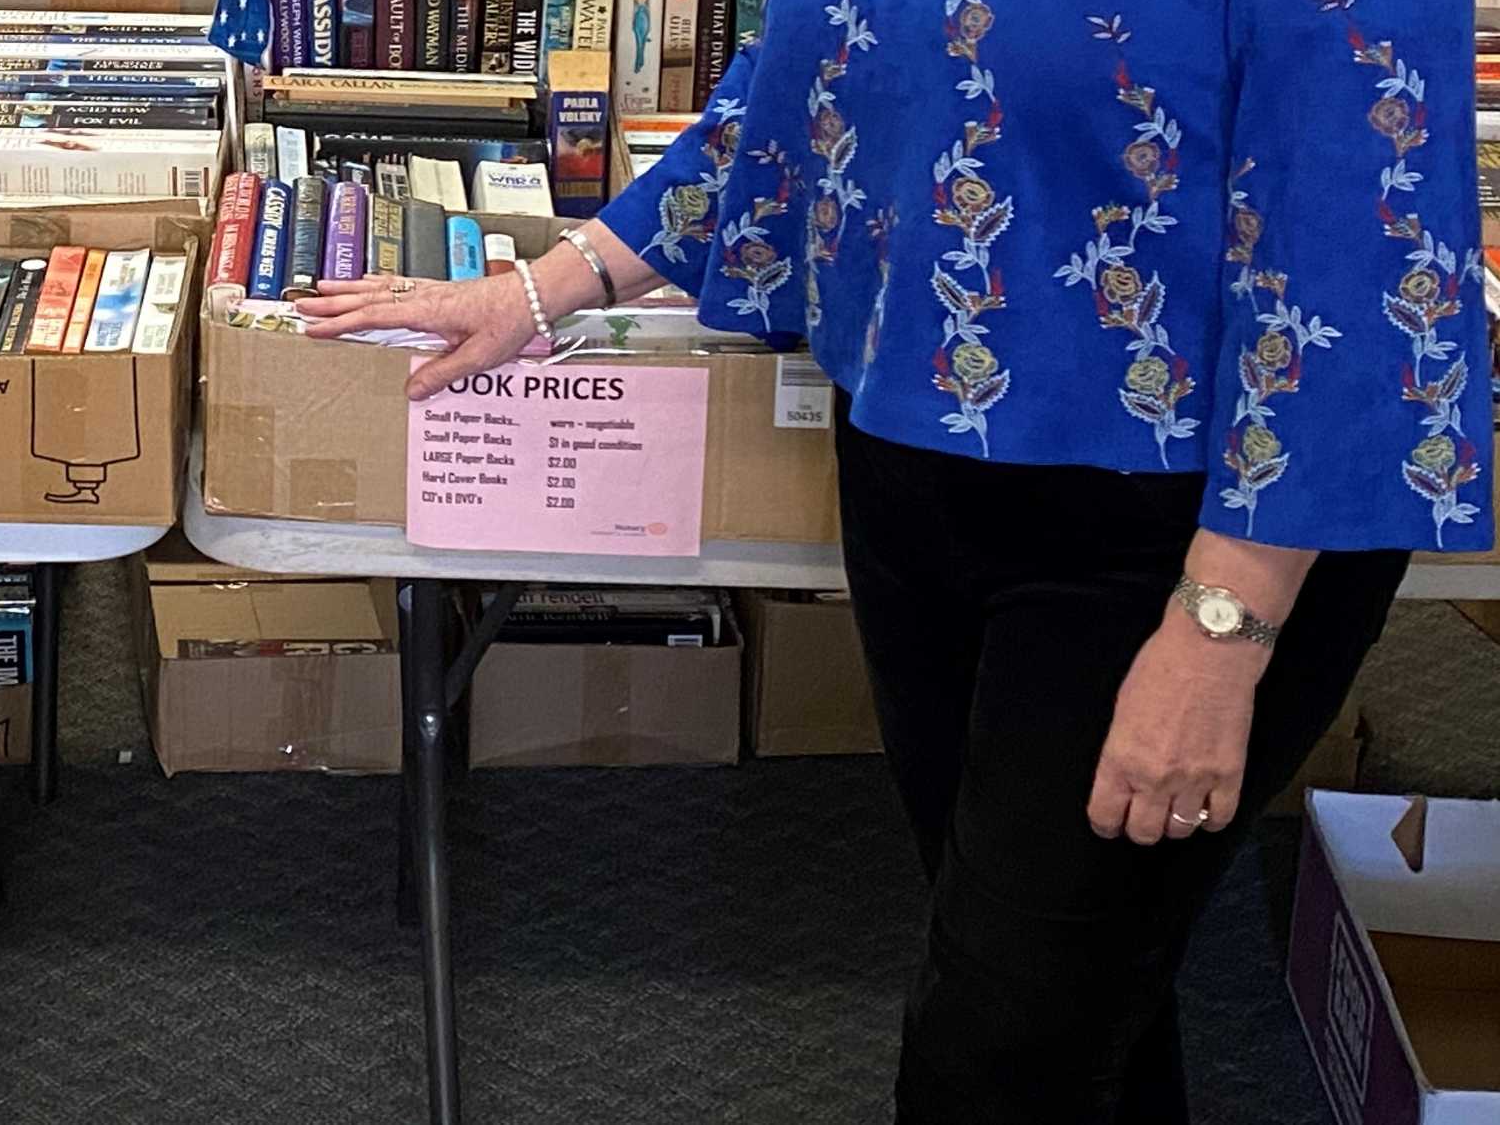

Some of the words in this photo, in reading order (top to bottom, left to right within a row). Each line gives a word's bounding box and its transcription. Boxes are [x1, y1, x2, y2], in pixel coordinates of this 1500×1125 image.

[457, 6, 469, 30] THE
[517, 10, 537, 35] THE
[712, 2, 726, 34] THAT
[425, 8, 441, 66] WAYMAN
[271, 77, 325, 87] CLARA
[330, 78, 396, 90] CALLAN
[563, 97, 599, 108] PAULA
[448, 373, 514, 398] OOK
[524, 376, 624, 401] PRICES
[425, 410, 451, 423] Small
[453, 412, 482, 426] Paper
[424, 431, 451, 443] Small
[452, 432, 481, 446] Paper
[483, 434, 512, 446] Backs
[561, 438, 571, 449] in
[572, 438, 596, 451] good
[598, 439, 643, 451] condition
[455, 453, 485, 466] Paper
[486, 454, 515, 466] Backs
[547, 457, 577, 469] $2.00
[422, 471, 446, 484] Hard
[449, 472, 477, 485] Cover
[479, 473, 508, 486] Books
[547, 477, 576, 489] $2.00
[546, 496, 575, 509] $2.00
